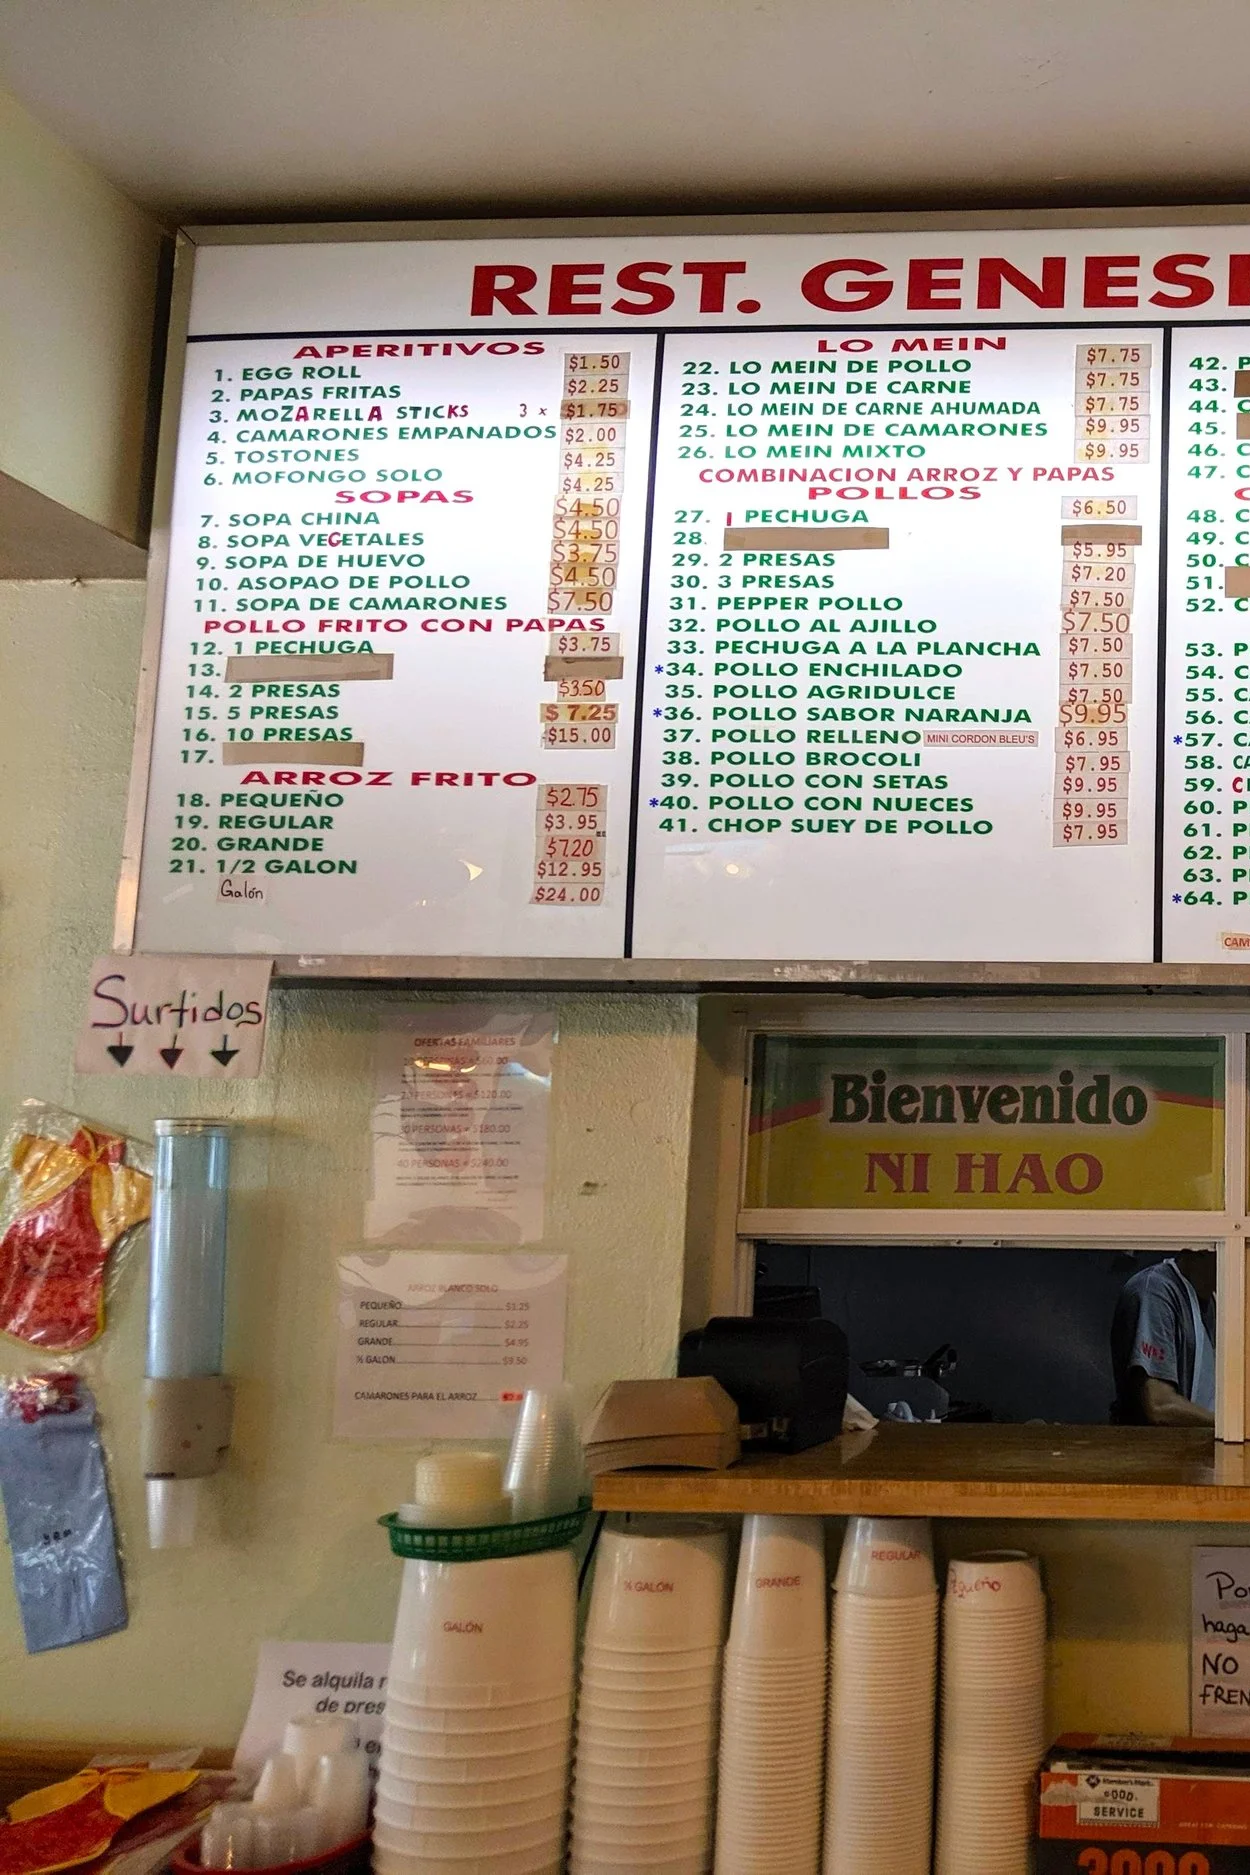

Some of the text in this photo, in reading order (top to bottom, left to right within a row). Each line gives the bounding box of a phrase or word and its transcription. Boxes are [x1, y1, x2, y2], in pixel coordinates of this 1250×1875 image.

[471, 261, 760, 316] REST.
[293, 342, 544, 359] APERITIVOS
[818, 337, 1006, 352] LO MEIN
[1087, 344, 1140, 365] $7.75
[569, 354, 621, 373] $1.50
[683, 360, 971, 374] 22. LO MEIN DE POLLO
[215, 366, 361, 381] 1. EGG ROLL
[209, 405, 468, 423] 3. MOZARELLA STICKS
[335, 491, 473, 503] SOPAS
[809, 487, 981, 500] POLLOS
[667, 641, 1040, 656] 33. PECHUGA A LA PLANCHA
[183, 727, 354, 742] 16. 10 PRESAS
[547, 728, 613, 744] $15.00
[927, 735, 1035, 743] MINI CORDON BLEU'S
[1185, 756, 1222, 769] 58.
[240, 771, 536, 786] ARROZ FRITO
[221, 879, 263, 899] Galón
[534, 886, 601, 902] $24.00
[92, 974, 265, 1028] Surtidos
[830, 1070, 1149, 1126] Bienvenido
[865, 1152, 1105, 1194] NI HAO
[360, 1300, 402, 1310] PEQUEÑO
[359, 1320, 398, 1328] REGULAR
[358, 1338, 392, 1346] GRANDE
[355, 1391, 477, 1400] CAMARONES PARA EL ARROZ
[870, 1550, 922, 1562] REGULAR
[755, 1576, 802, 1589] GRANDE
[443, 1620, 484, 1634] GALÓN
[1202, 1655, 1239, 1676] NO
[282, 1670, 374, 1692] Se alquila
[1093, 1807, 1144, 1818] SERVICE
